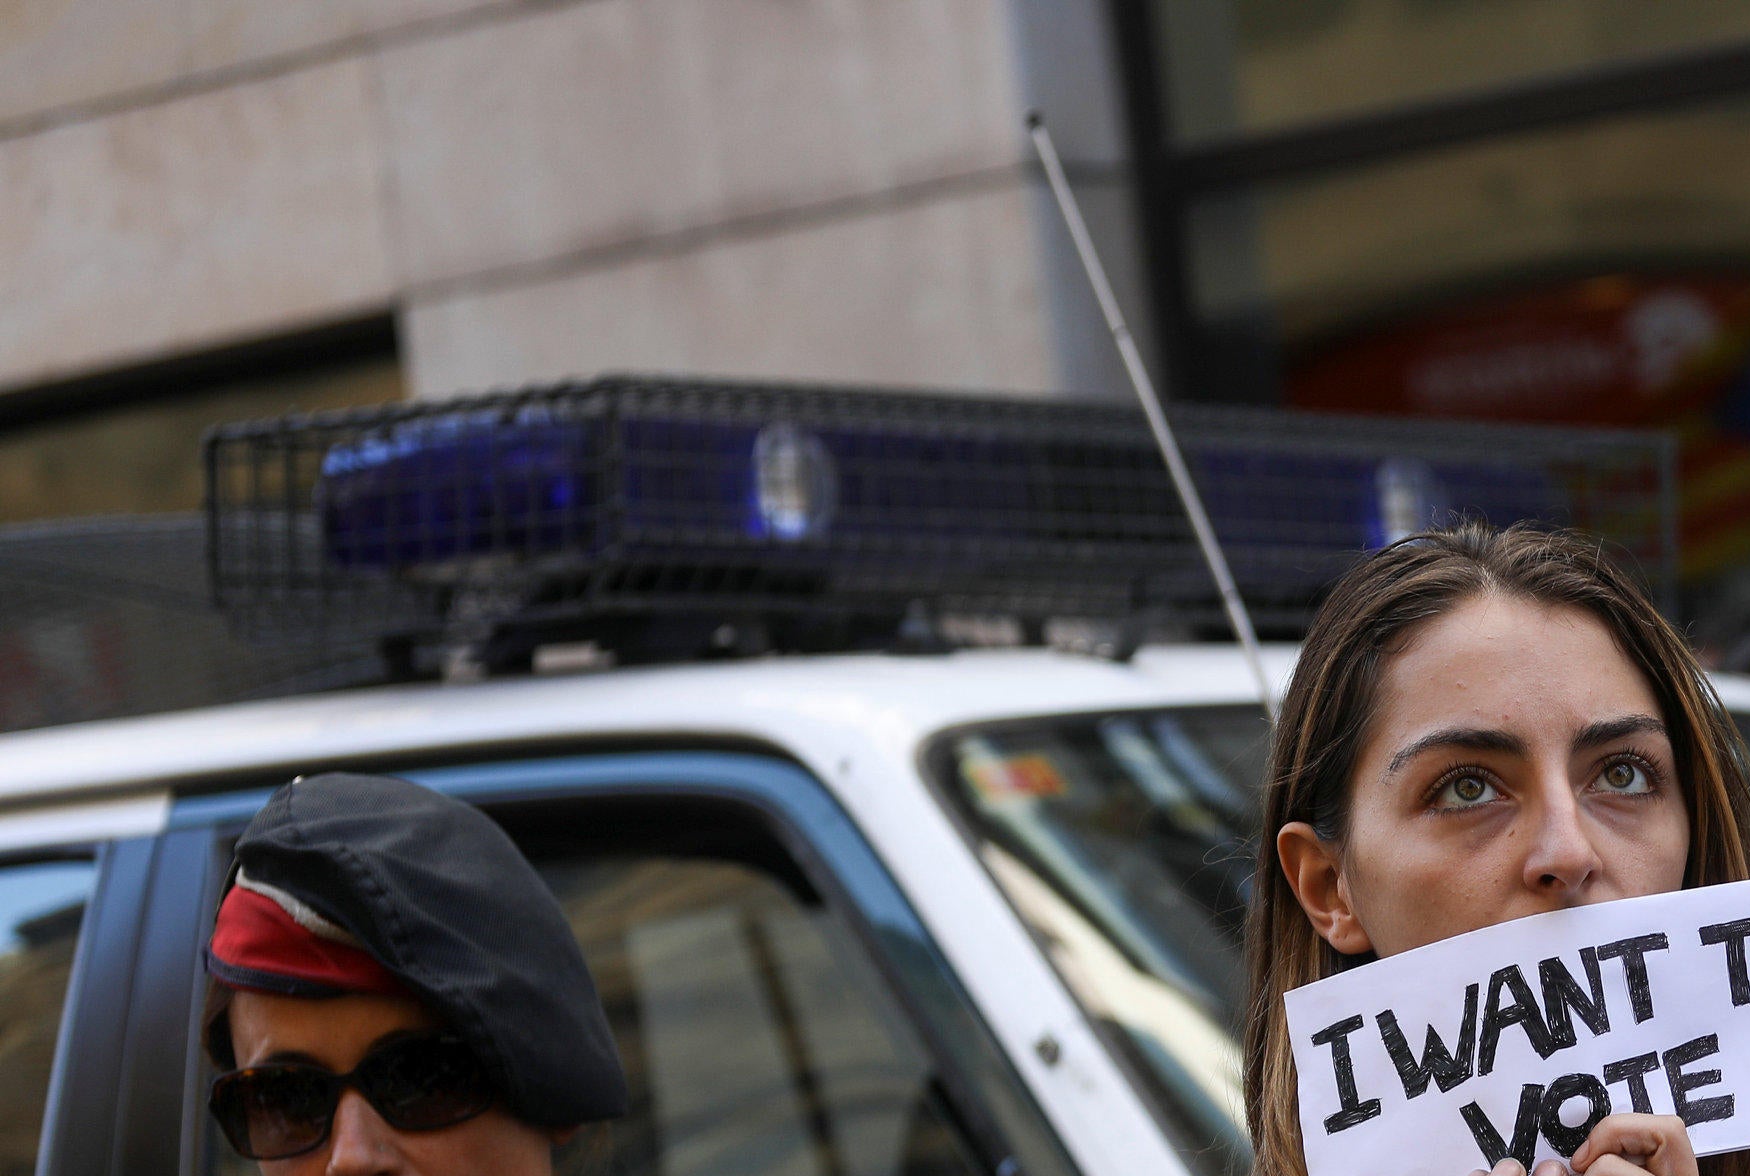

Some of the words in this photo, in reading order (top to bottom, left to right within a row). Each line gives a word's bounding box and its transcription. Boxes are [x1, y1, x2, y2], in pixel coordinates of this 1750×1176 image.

[1310, 1013, 1383, 1135] I
[1375, 932, 1670, 1100] WANT
[1459, 1032, 1736, 1176] VOTE
